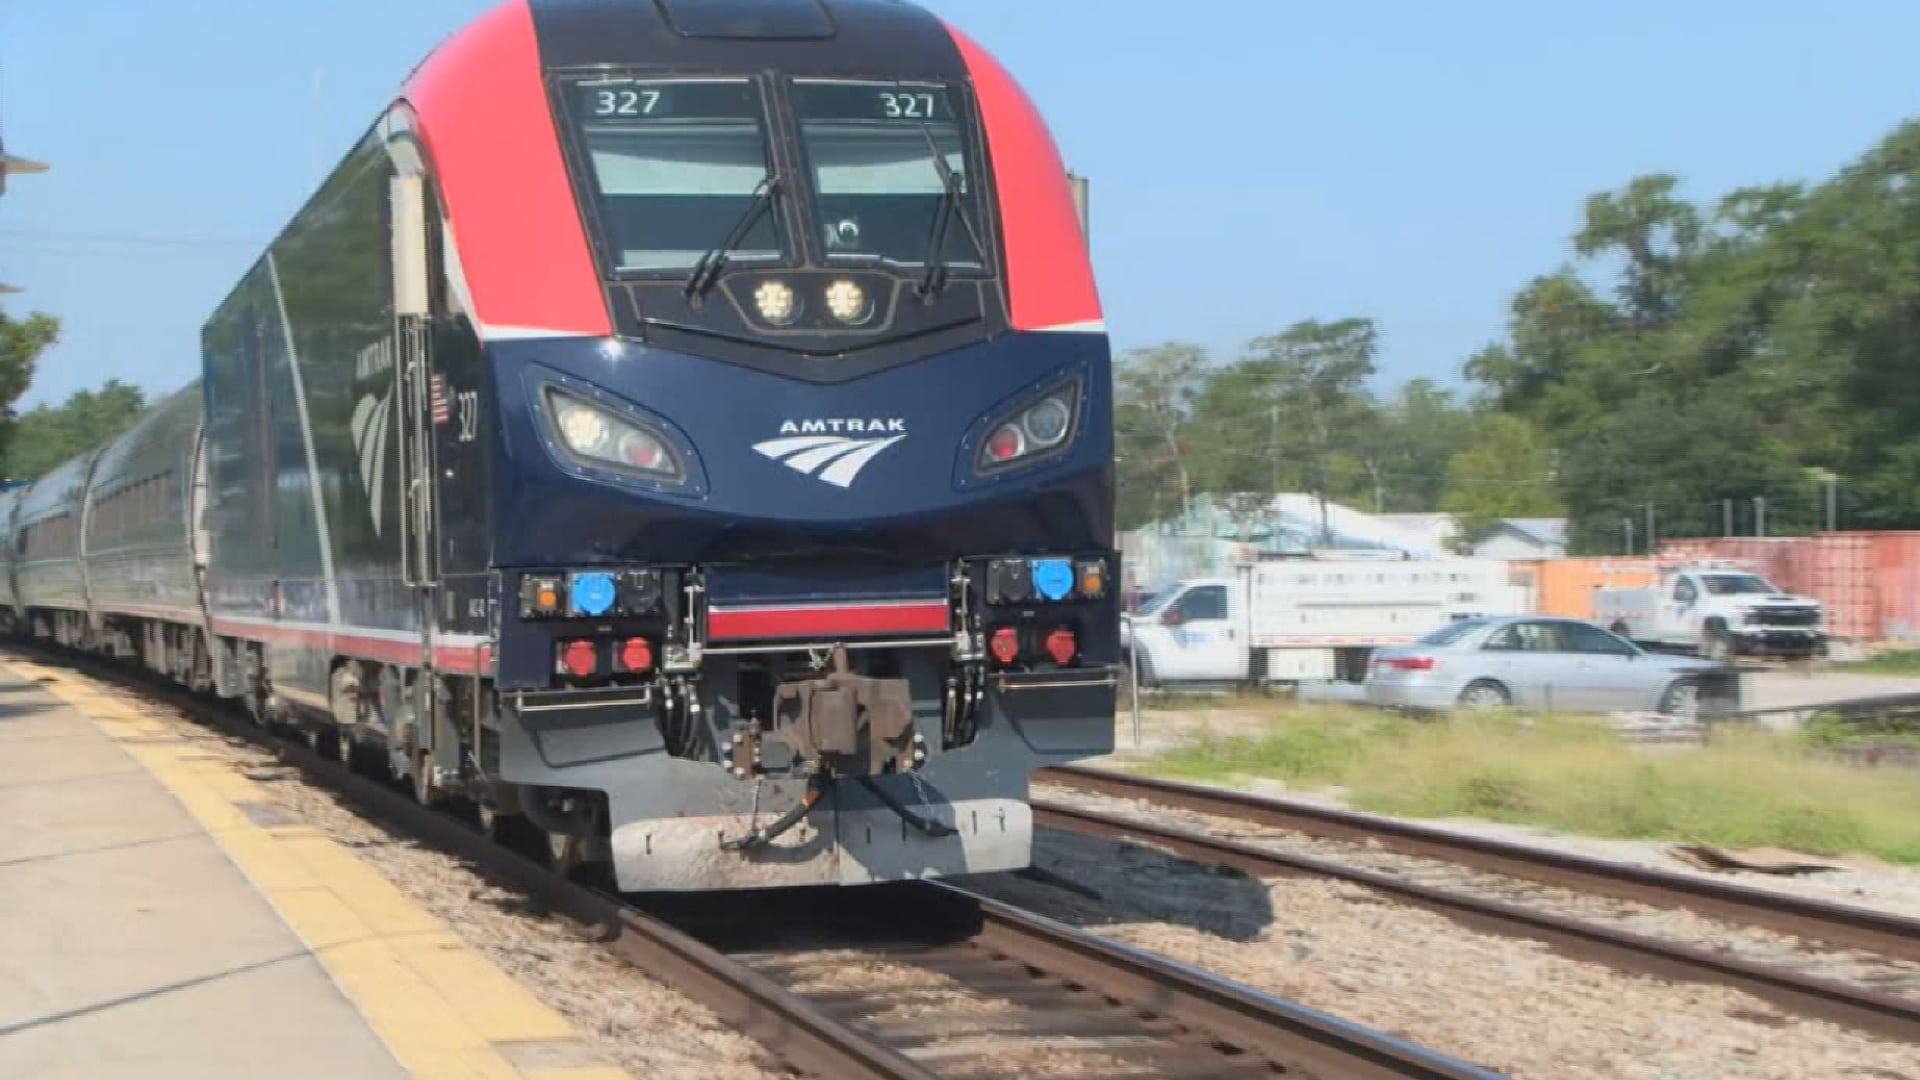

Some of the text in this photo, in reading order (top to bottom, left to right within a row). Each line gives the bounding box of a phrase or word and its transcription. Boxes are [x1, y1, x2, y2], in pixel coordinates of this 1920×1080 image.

[595, 91, 661, 114] 327
[880, 93, 935, 117] 327
[458, 391, 478, 442] 327
[780, 418, 908, 432] AMTRAK
